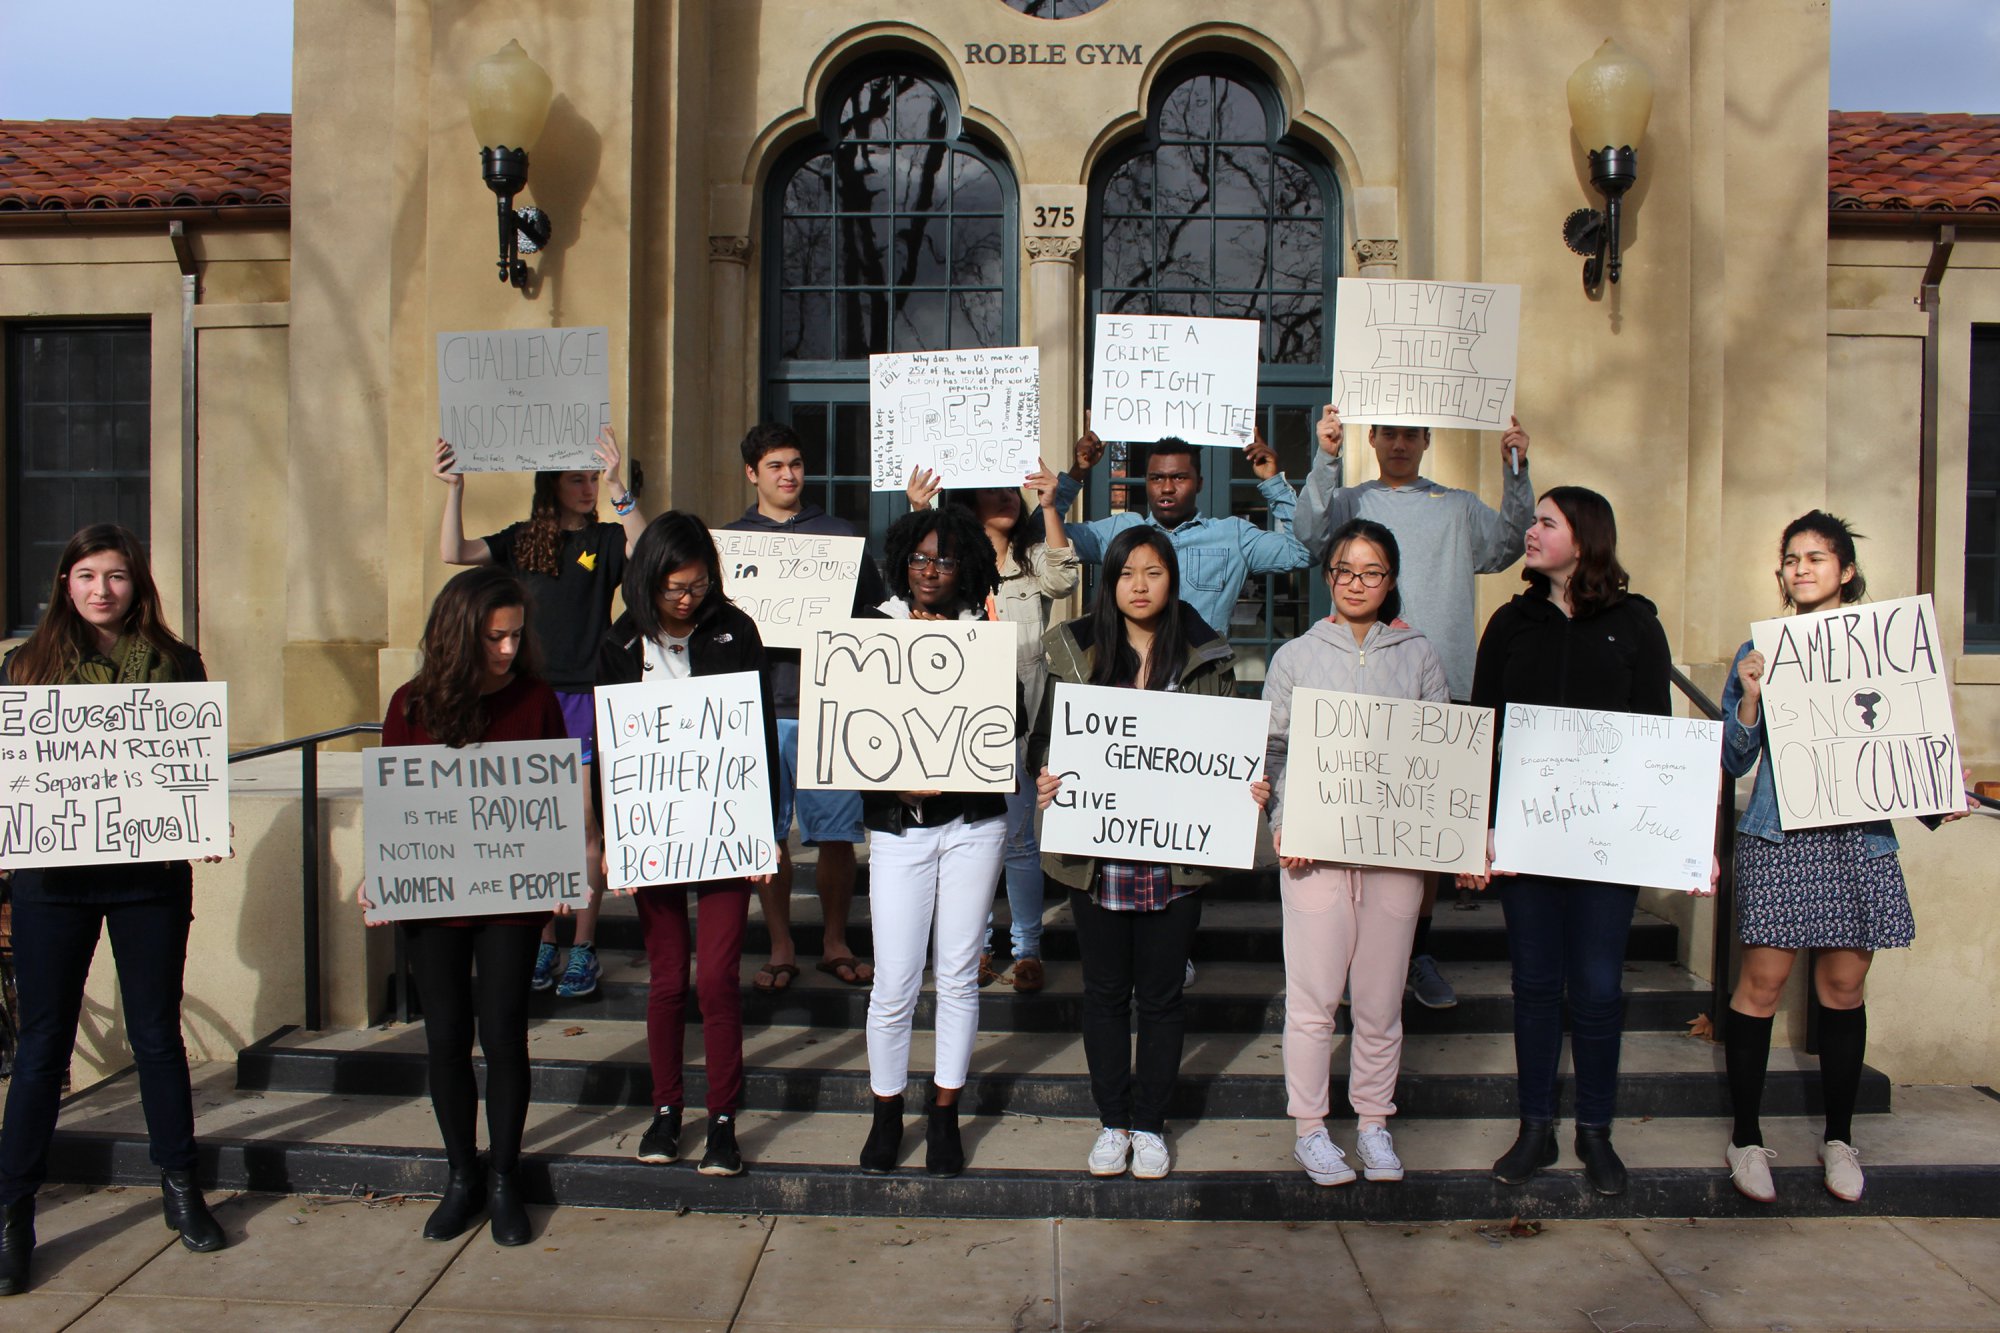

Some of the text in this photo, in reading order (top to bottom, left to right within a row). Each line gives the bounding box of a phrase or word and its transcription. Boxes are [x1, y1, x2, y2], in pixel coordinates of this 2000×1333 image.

[965, 43, 1143, 65] ROBLE GYM
[1033, 206, 1074, 228] 375
[1365, 282, 1496, 333] NEVER
[1108, 323, 1199, 345] IS IT A
[1371, 328, 1480, 374] STOP
[444, 332, 602, 383] CHALLENGE
[912, 354, 929, 366] Why
[1019, 355, 1029, 364] up
[930, 366, 938, 374] of
[944, 367, 955, 375] the
[994, 367, 1023, 377] prison
[1106, 344, 1170, 362] CRIME
[509, 388, 525, 397] the
[992, 377, 1003, 385] the
[1102, 370, 1215, 395] TO FIGHT
[1336, 370, 1511, 424] FIGHTING
[874, 430, 884, 439] to
[901, 392, 993, 444] FREE
[1104, 397, 1255, 435] FOR MY LIFE
[734, 559, 858, 581] in YOUR
[1766, 604, 1937, 685] AMERICA
[0, 688, 222, 736] Education
[607, 697, 755, 749] LOVE is NOT
[1065, 701, 1137, 737] LOVE
[1314, 699, 1484, 750] DON'T BUY
[1509, 706, 1718, 742] SAY THINGS THAT ARE
[1808, 678, 1937, 737] NOT
[2, 737, 211, 763] is a HUMAN RIGHT.
[817, 698, 1016, 784] love
[1577, 727, 1623, 755] KIND
[124, 770, 143, 789] is
[152, 763, 219, 785] STILL
[378, 753, 578, 788] FEMINISM
[610, 747, 759, 798] EITHER/OR
[1105, 743, 1261, 782] GENEROUSLY
[1317, 746, 1440, 780] WHERE YOU
[1521, 757, 1581, 766] Encouragement
[1779, 734, 1954, 820] ONE COUNTRY
[1053, 771, 1117, 810] GIVE
[1386, 783, 1426, 811] NOT
[1450, 788, 1482, 820] BE
[0, 795, 211, 858] Not Equal.
[404, 796, 567, 832] IS THE RADICAL
[613, 800, 737, 841] LOVE IS
[1521, 789, 1600, 832] Helpful
[1630, 805, 1682, 842] True
[379, 842, 525, 861] NOTION THAT
[1093, 817, 1211, 855] JOYFULLY.
[1341, 814, 1465, 863] HIRED
[617, 834, 772, 888] BOTH/AND
[378, 872, 581, 905] WOMEN ARE PEOPLE
